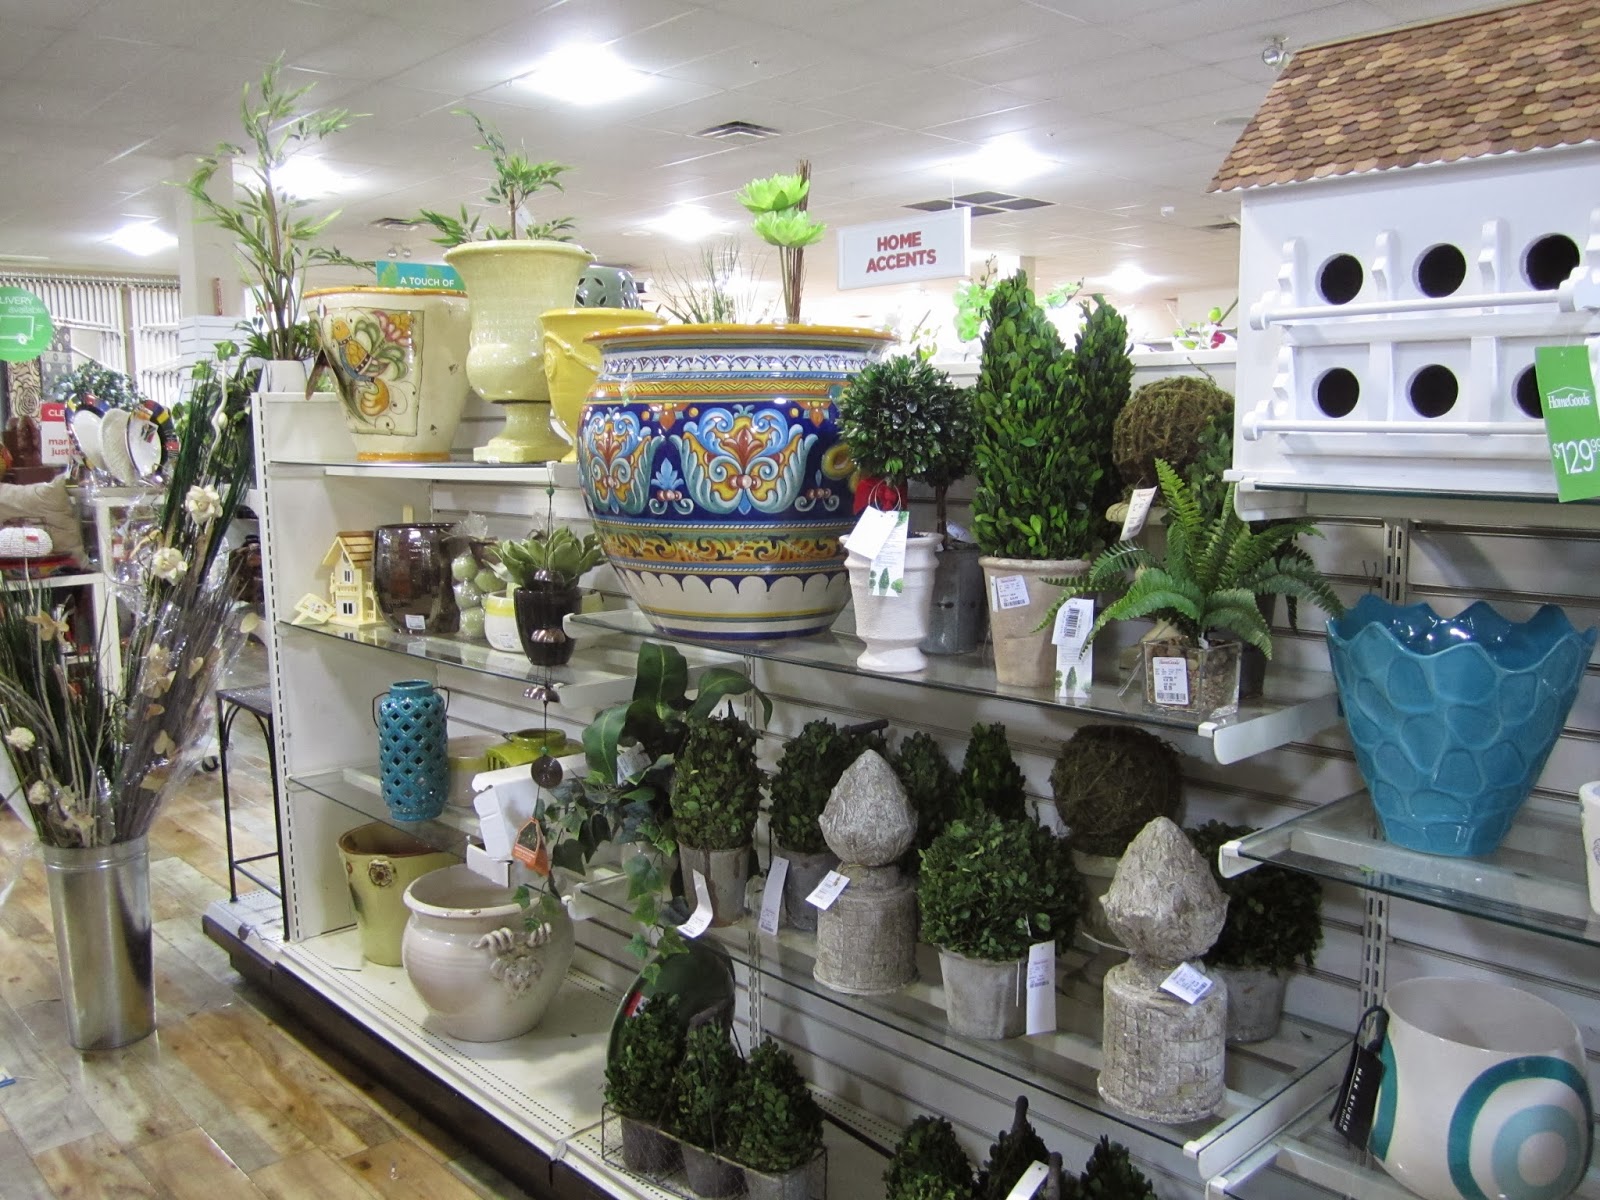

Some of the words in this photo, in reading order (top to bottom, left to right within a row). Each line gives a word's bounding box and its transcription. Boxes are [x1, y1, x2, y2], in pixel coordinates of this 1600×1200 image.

[876, 231, 922, 252] HOME
[866, 249, 937, 273] ACCENTS
[400, 276, 407, 285] A
[409, 277, 440, 287] TOUCH
[442, 279, 455, 287] OF
[1548, 392, 1590, 409] HomeGoods
[51, 447, 69, 457] just
[1353, 1067, 1362, 1090] MAX
[1342, 1094, 1355, 1131] STUDIO
